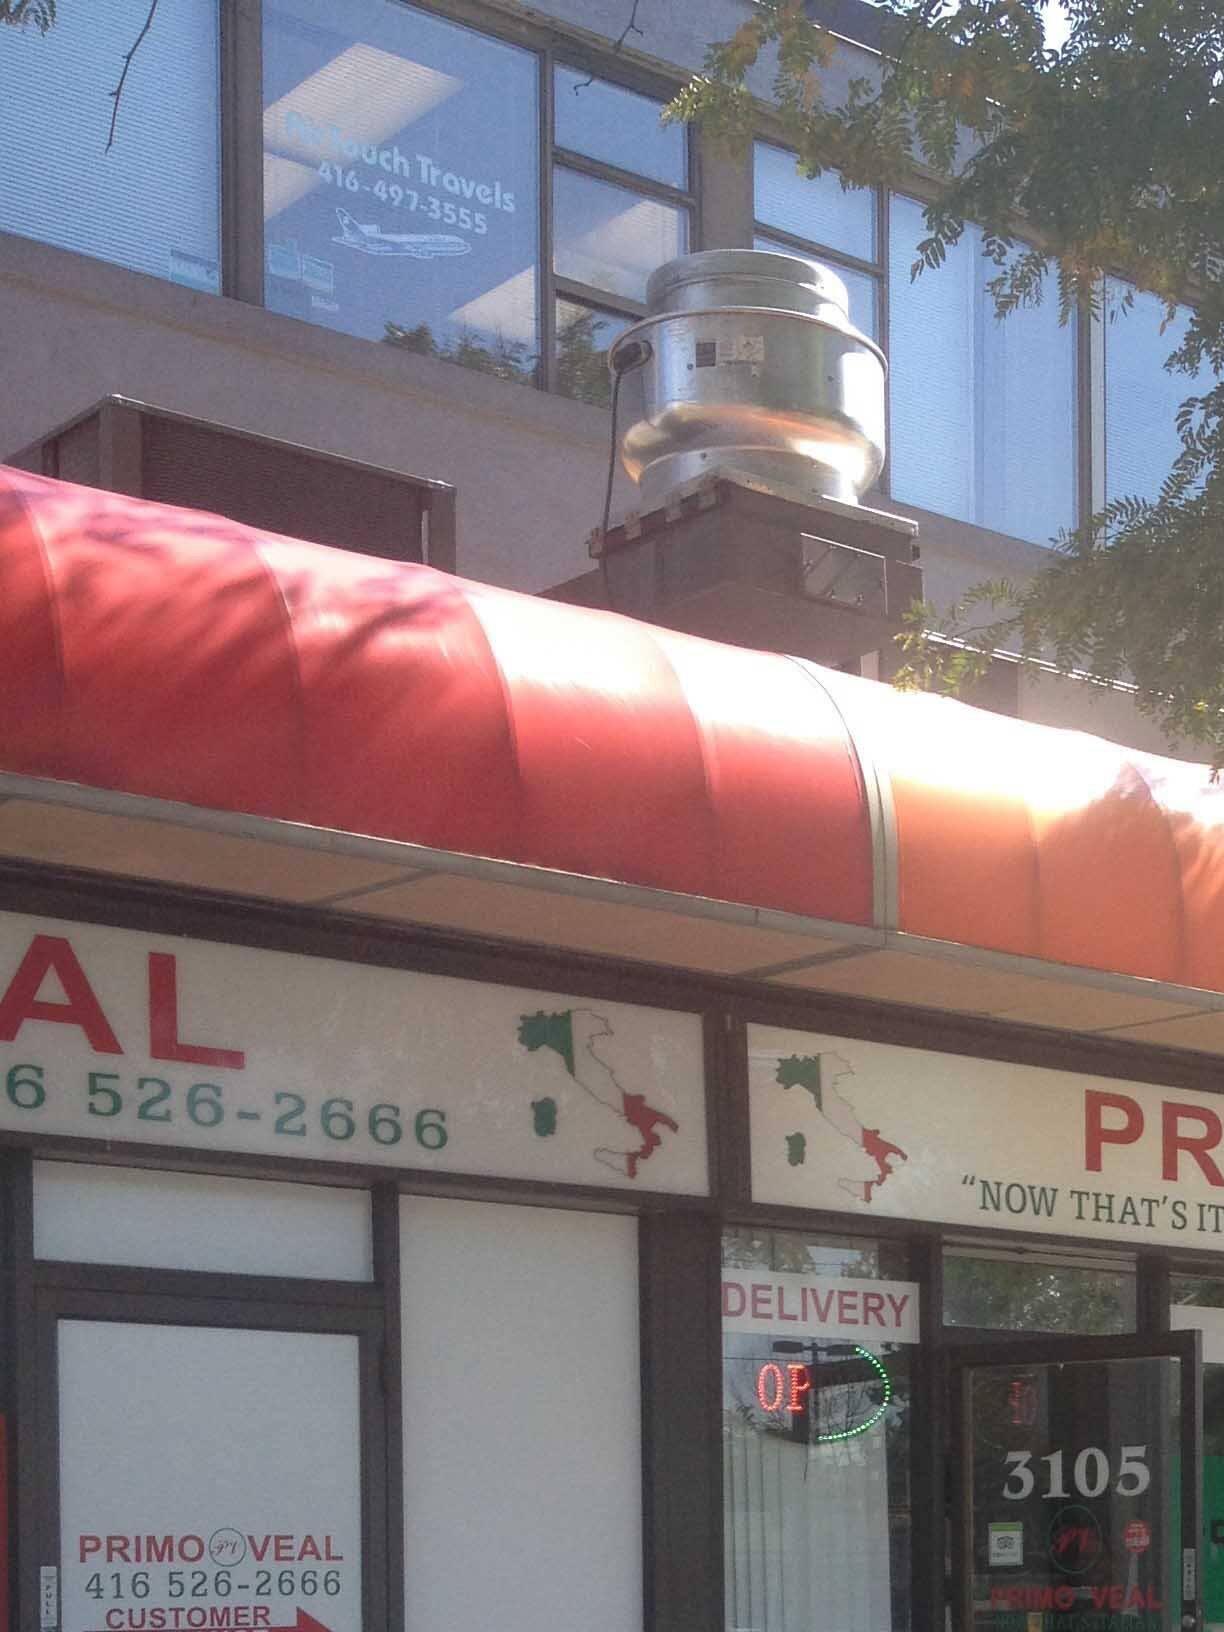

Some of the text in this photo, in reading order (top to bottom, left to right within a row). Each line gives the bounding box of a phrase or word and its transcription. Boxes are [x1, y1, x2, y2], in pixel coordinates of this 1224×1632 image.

[319, 160, 488, 235] 416-497-3555
[416, 153, 515, 213] Travels
[0, 934, 245, 1069] AL
[87, 1072, 449, 1150] 526-2666
[1070, 1189, 1189, 1231] THAT'S
[721, 1281, 909, 1328] DELIVERY
[1002, 1444, 1151, 1500] 3105
[79, 1534, 205, 1563] PRIMO
[246, 1534, 344, 1562] VEAL
[84, 1570, 341, 1600] 416 526-2666
[989, 1583, 1163, 1612] PRIMO VEAL
[105, 1605, 272, 1630] CUSTOMER
